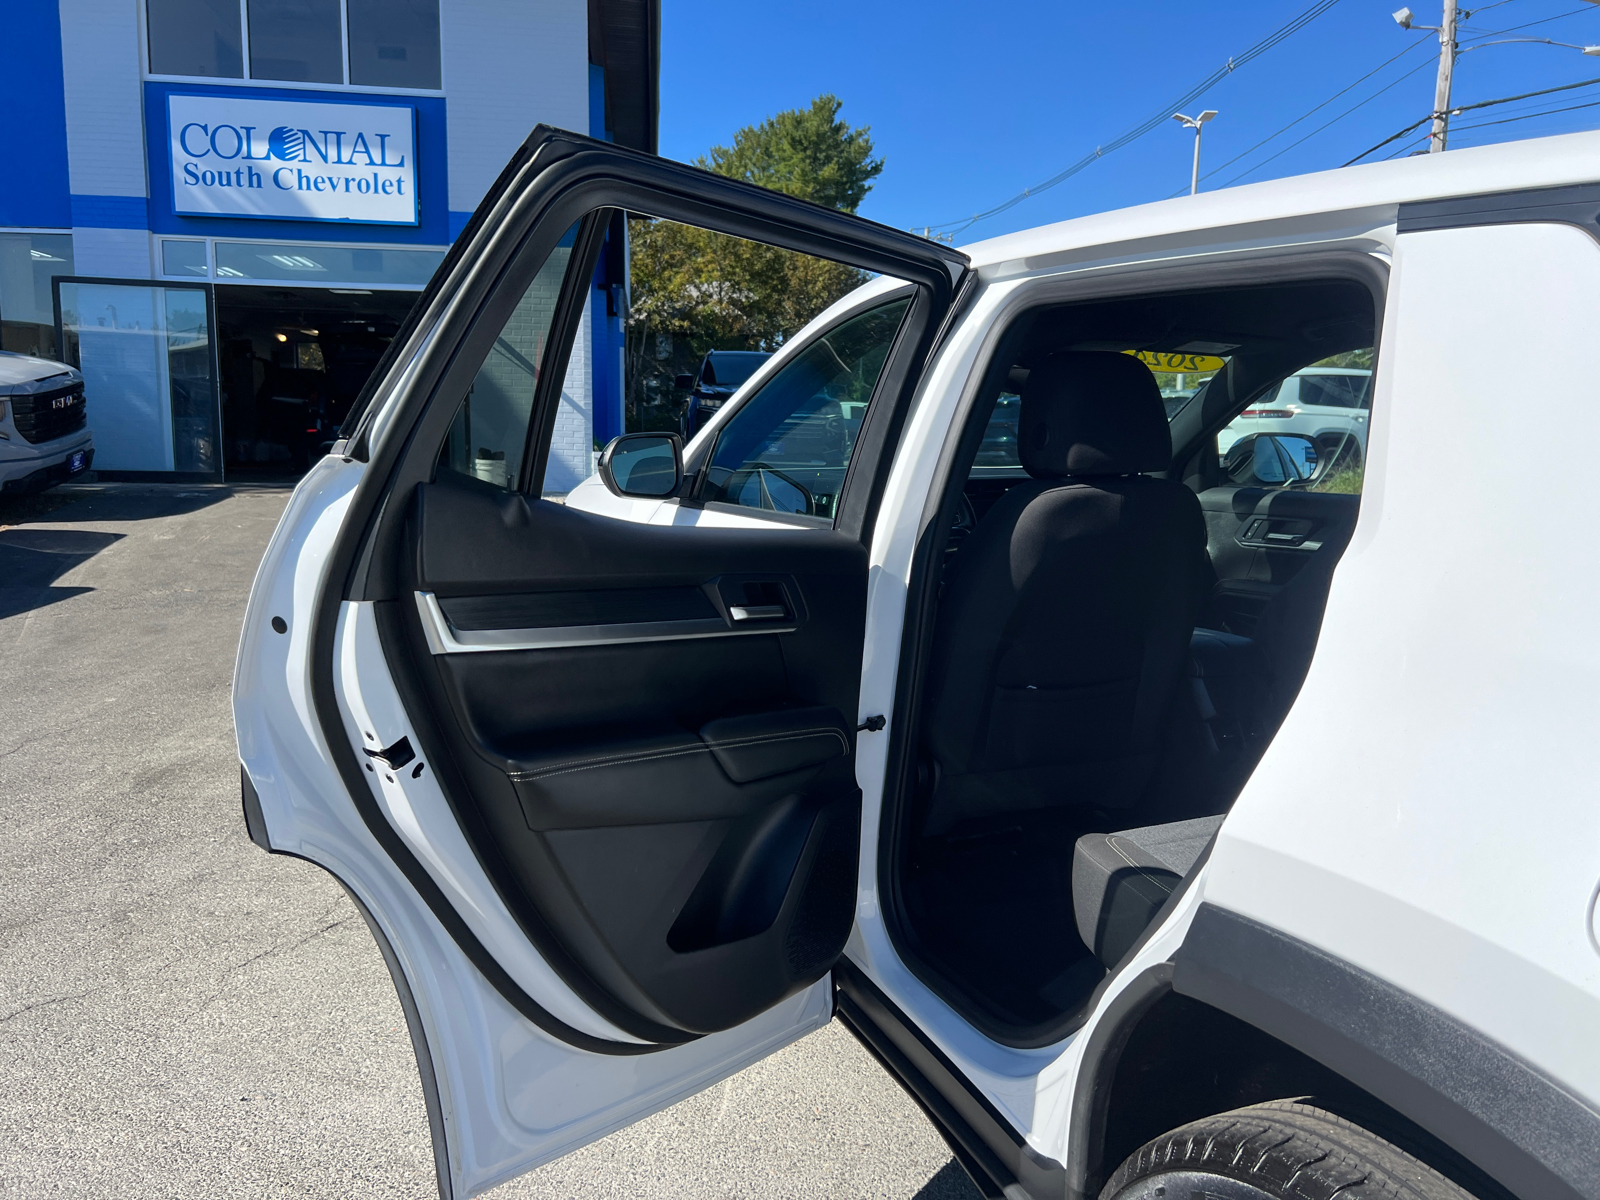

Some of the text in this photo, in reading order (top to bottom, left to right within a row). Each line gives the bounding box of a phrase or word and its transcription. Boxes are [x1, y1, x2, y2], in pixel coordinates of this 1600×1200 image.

[179, 122, 406, 168] COLONIAL
[183, 162, 406, 196] South Chevrolet
